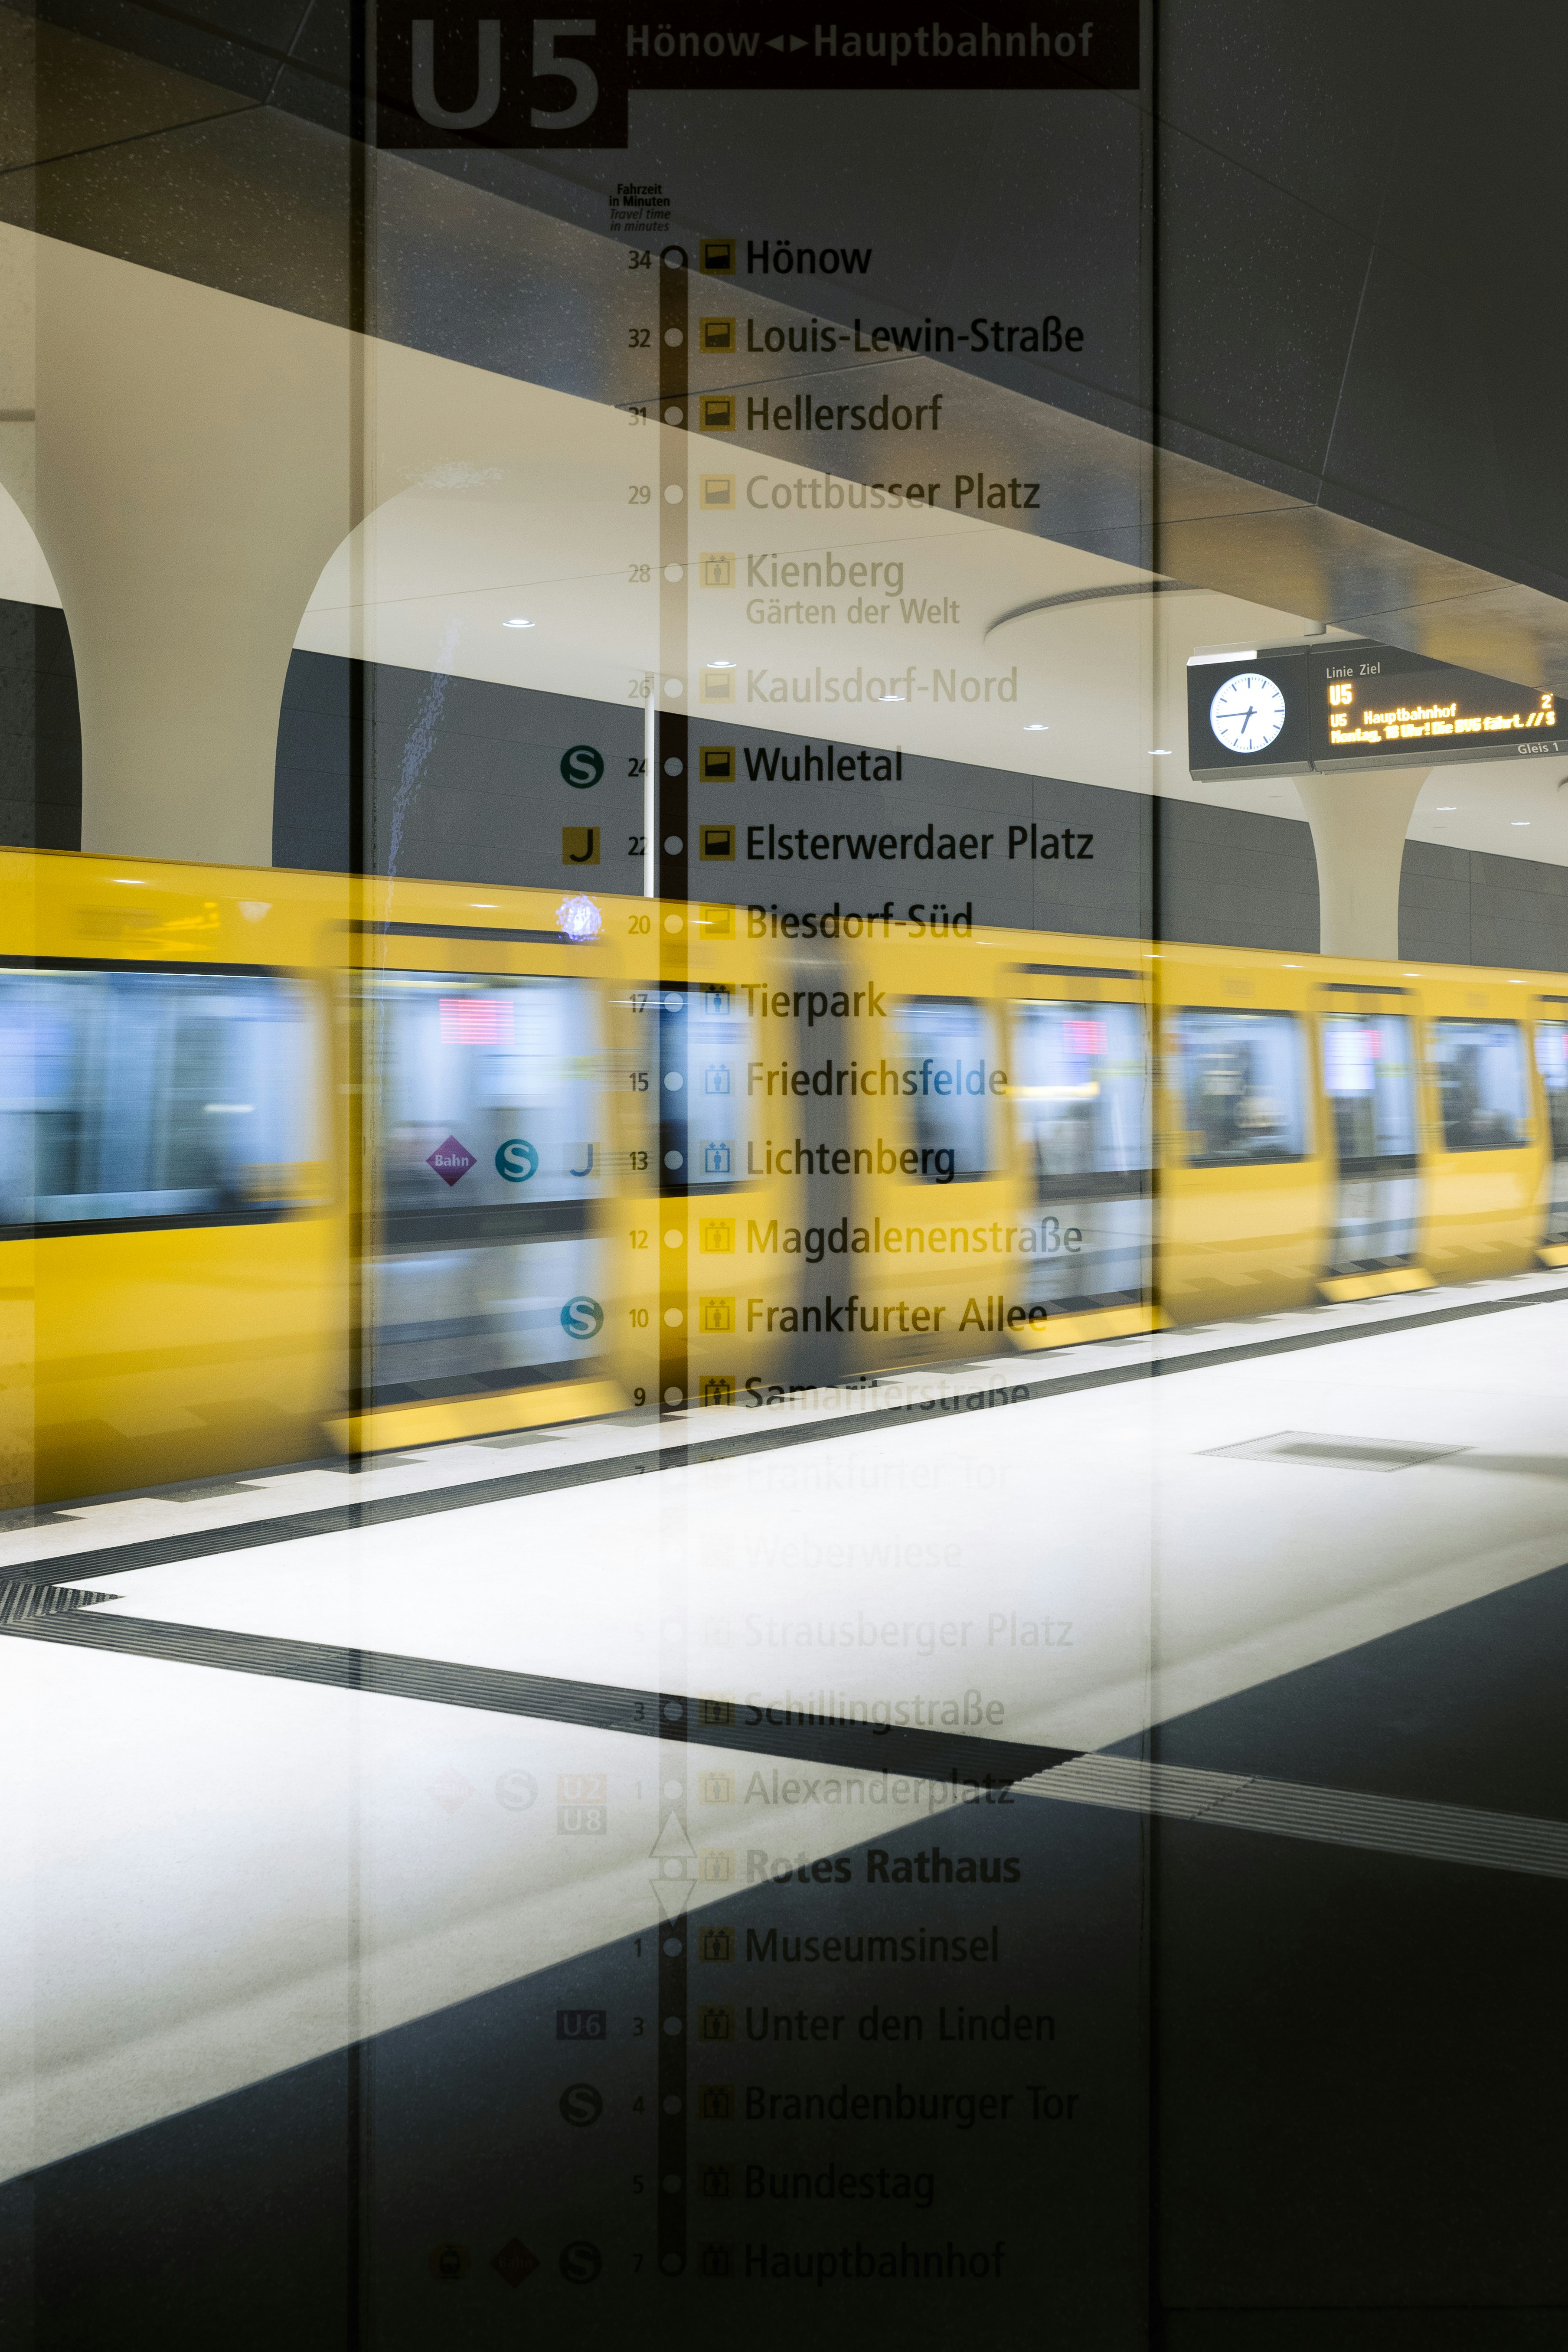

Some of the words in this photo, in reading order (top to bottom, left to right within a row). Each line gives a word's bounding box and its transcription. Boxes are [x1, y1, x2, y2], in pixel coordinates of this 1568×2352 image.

[626, 23, 761, 58] Hönow
[813, 23, 1094, 66] Hauptbahnhof
[408, 18, 599, 130] U5
[609, 196, 620, 207] in
[623, 196, 671, 207] Minuten
[617, 183, 663, 195] Fahrzeit
[610, 208, 643, 219] Travel
[646, 208, 671, 219] time
[610, 221, 621, 232] in
[624, 221, 670, 232] minutes
[628, 250, 652, 269] 34
[746, 238, 873, 274] Hönow
[628, 329, 651, 348] 32
[746, 314, 1085, 353] Louis-Lewin-Straße
[628, 408, 648, 427] 31
[747, 394, 943, 431] Hellersdorf
[628, 485, 651, 505] 29
[746, 473, 941, 510] Cottbusser
[954, 473, 1040, 510] Platz
[628, 564, 651, 583] 28
[746, 551, 905, 597] Kienberg
[746, 598, 836, 624] Gärten
[847, 597, 891, 624] der
[898, 597, 961, 624] Welt
[628, 679, 651, 699] 26
[747, 666, 1018, 703] Kaulsdorf-Nord
[1326, 666, 1353, 679] Linie
[1359, 662, 1381, 676] Ziel
[1329, 683, 1352, 706] U5
[1330, 713, 1347, 728] U5
[1364, 703, 1457, 725] Hauptbahnhof
[1331, 728, 1382, 744] Montag,
[1431, 720, 1454, 735] Die
[1454, 718, 1482, 734] BVG
[628, 758, 649, 777] 24
[743, 745, 904, 782] Wuhletal
[1518, 742, 1549, 755] Gleis
[1552, 742, 1560, 752] 1
[747, 823, 994, 861] Elsterwerdaer
[1008, 823, 1094, 861] Platz
[628, 915, 651, 935] 20
[747, 902, 973, 939] Biesdorf-Süd
[629, 994, 648, 1013] 17
[741, 981, 887, 1026] Tierpark
[629, 1073, 649, 1092] 15
[747, 1059, 1007, 1097] Friedrichsfelde
[435, 1154, 469, 1166] Bahn
[629, 1151, 648, 1170] 13
[747, 1138, 954, 1183] Lichtenberg
[629, 1230, 649, 1249] 12
[747, 1216, 1082, 1264] Magdalenenstraße
[629, 1309, 649, 1328] 10
[747, 1295, 947, 1333] Frankfurter
[958, 1295, 1048, 1333] Allee
[634, 1387, 647, 1407] 9
[745, 1374, 1030, 1412] Samariterstraße
[746, 1454, 947, 1491] Frankfurter
[958, 1454, 1011, 1491] Tor
[744, 1532, 963, 1569] Weberwiese
[745, 1611, 973, 1656] Strausberger
[988, 1611, 1074, 1649] Platz
[634, 1702, 646, 1722] 3
[744, 1689, 1005, 1735] Schillingstraße
[564, 1777, 601, 1800] U2
[635, 1781, 642, 1800] 1
[744, 1767, 1015, 1814] Alexanderplatz
[564, 1809, 601, 1832] U8
[745, 1849, 851, 1884] Rotes
[868, 1846, 1022, 1884] Rathaus
[634, 1939, 642, 1958] 1
[746, 1926, 1000, 1964] Museumsinsel
[563, 2013, 601, 2036] U6
[633, 2018, 644, 2037] 3
[746, 2008, 844, 2042] Unter
[858, 2006, 923, 2042] den
[939, 2006, 1056, 2042] Linden
[632, 2096, 646, 2115] 4
[746, 2084, 1016, 2130] Brandenburger
[1026, 2086, 1080, 2121] Tor
[633, 2175, 645, 2194] 5
[746, 2164, 935, 2208] Bundestag
[634, 2254, 645, 2273] 7
[746, 2241, 1006, 2287] Hauptbahnhof
